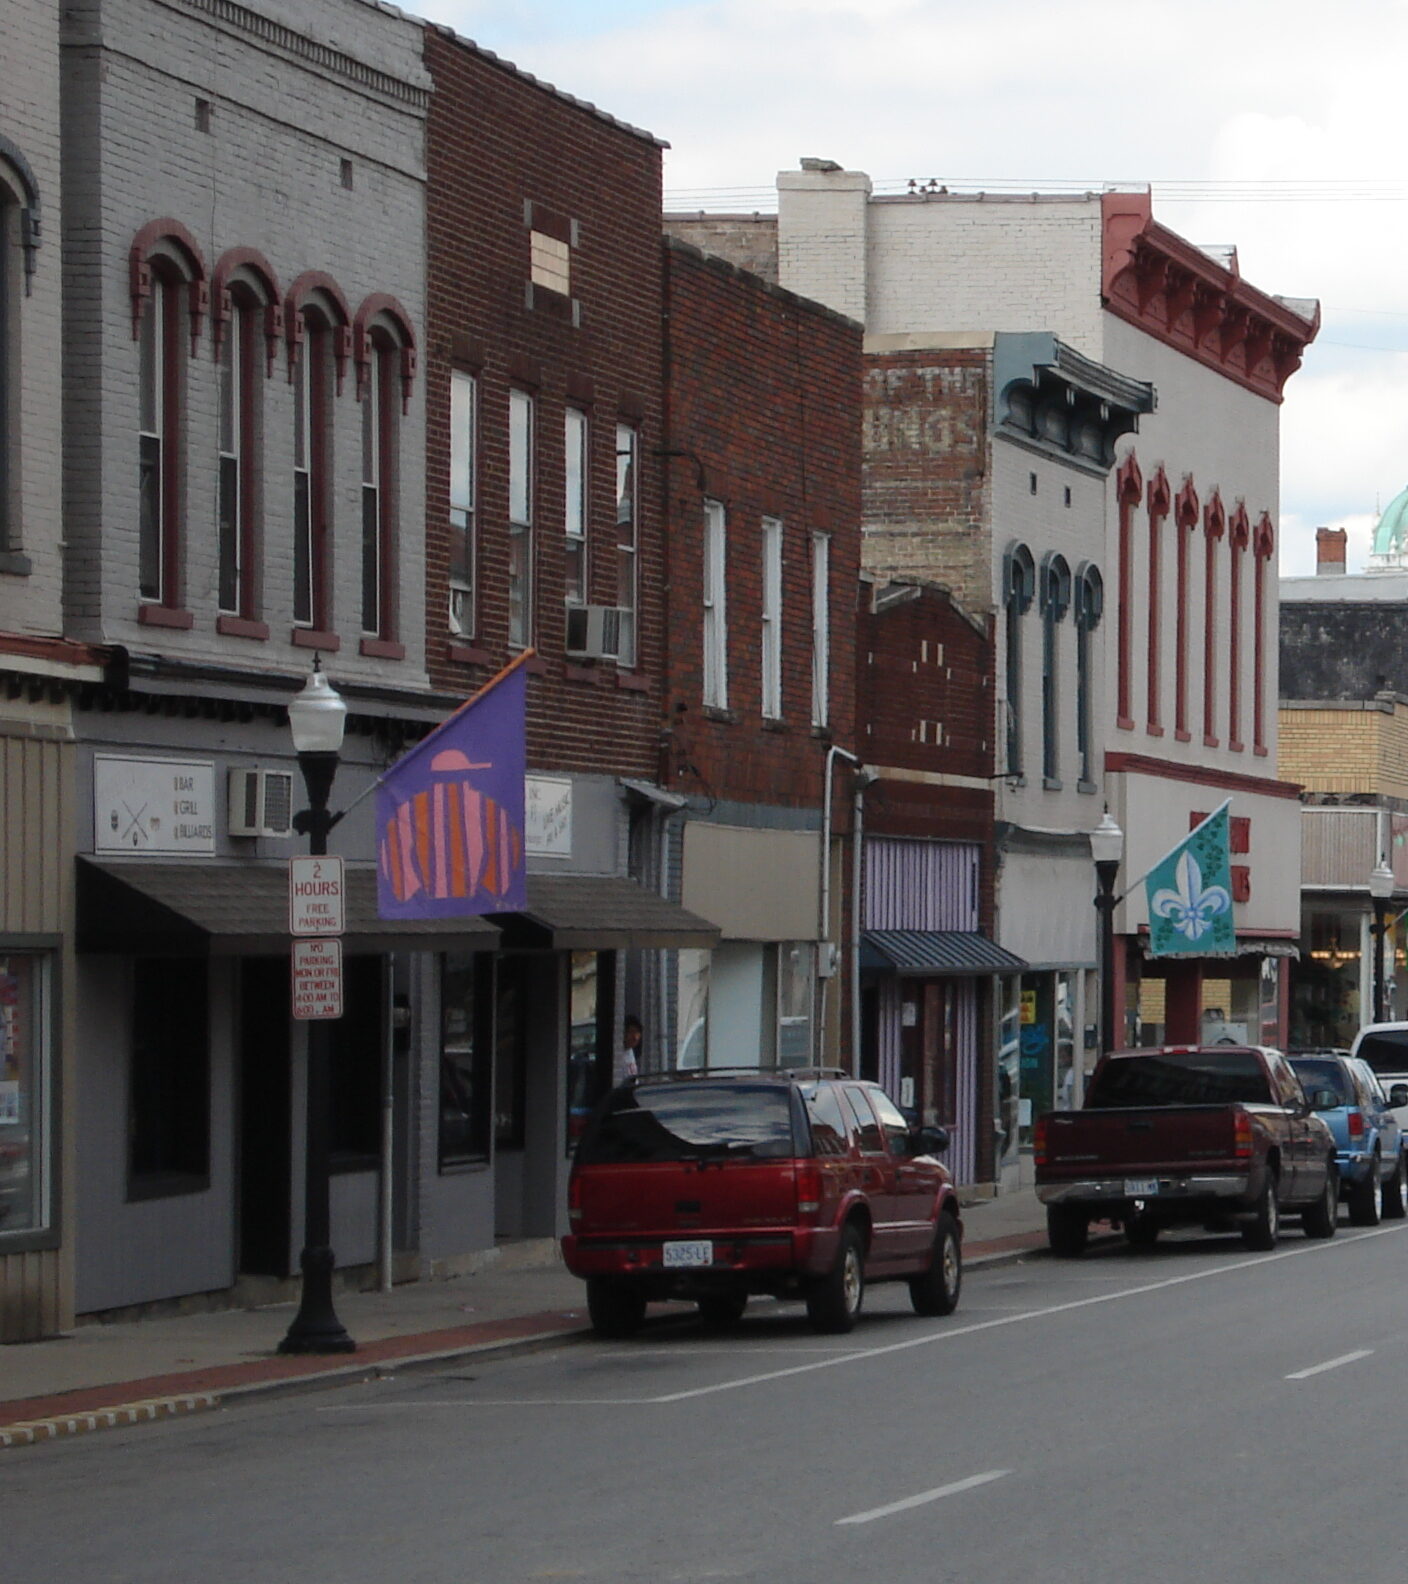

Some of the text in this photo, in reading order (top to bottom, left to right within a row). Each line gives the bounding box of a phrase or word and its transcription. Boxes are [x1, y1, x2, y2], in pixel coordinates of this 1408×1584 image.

[180, 776, 194, 791] BAR
[180, 800, 198, 815] GRILL
[313, 863, 321, 879] 2
[295, 881, 339, 897] HOURS
[306, 903, 330, 914] FREE
[298, 917, 337, 928] PARKING
[310, 944, 323, 953] NO
[300, 955, 334, 966] PARKING
[300, 981, 335, 991] BETWEEN
